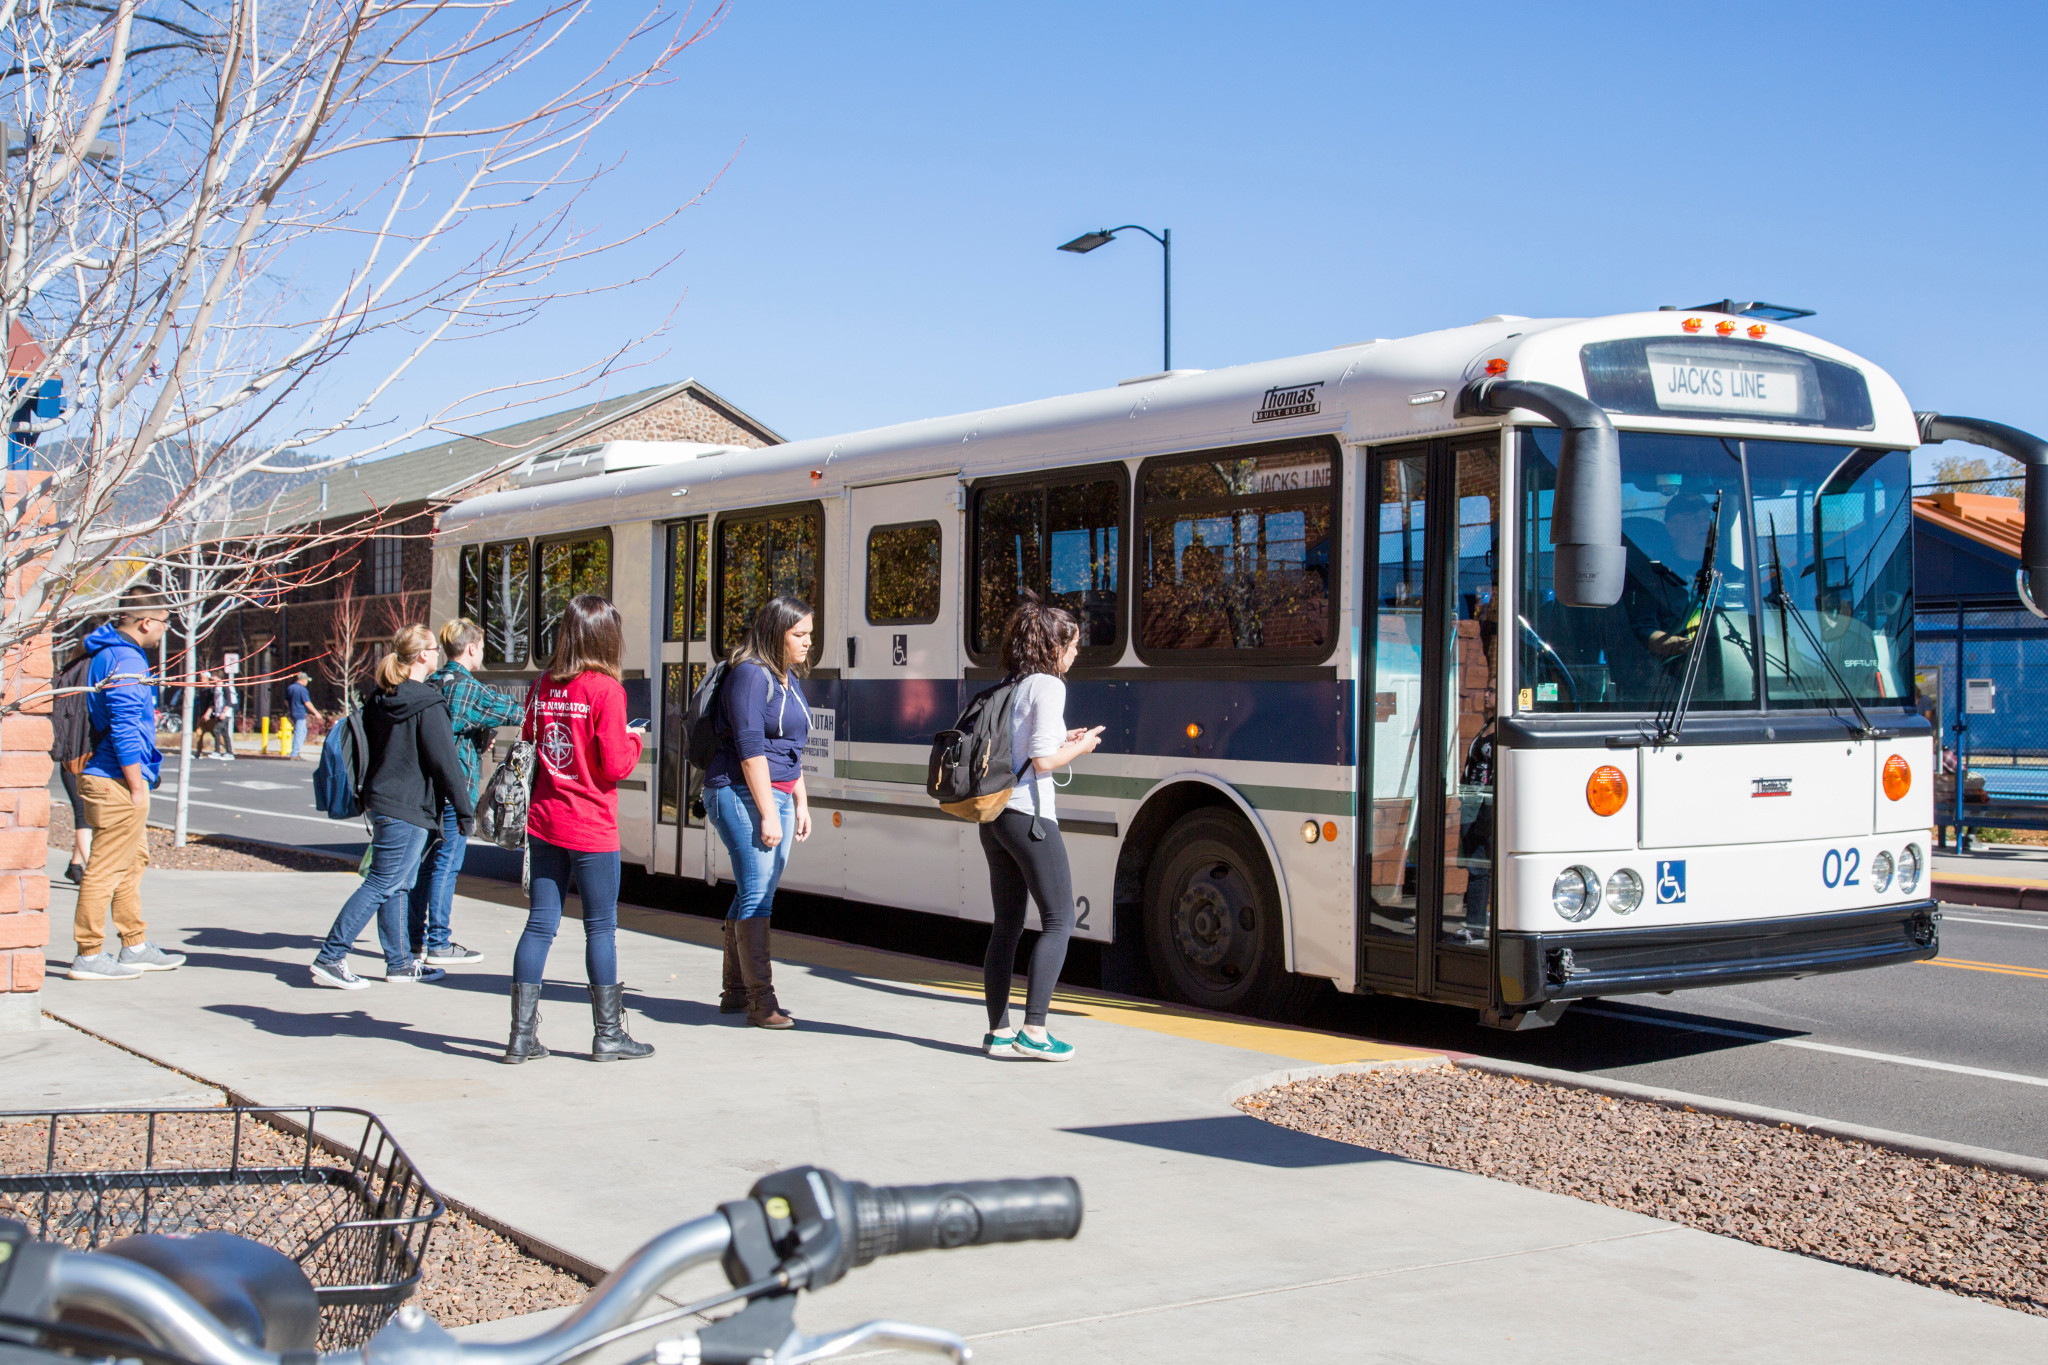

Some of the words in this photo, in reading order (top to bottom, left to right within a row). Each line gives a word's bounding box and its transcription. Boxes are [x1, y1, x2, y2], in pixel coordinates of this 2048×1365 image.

[1668, 367, 1723, 397] JACKS
[1731, 371, 1767, 399] LINE
[1261, 381, 1325, 410] Thomas
[1258, 409, 1283, 419] BUILT
[1285, 404, 1314, 415] BUSES
[1258, 471, 1299, 493] JACKS
[549, 689, 561, 698] I'M
[562, 689, 568, 698] A
[1521, 690, 1528, 699] 6
[547, 701, 591, 714] NAVIGATOR
[815, 714, 834, 731] UTAH
[1822, 847, 1860, 889] 02
